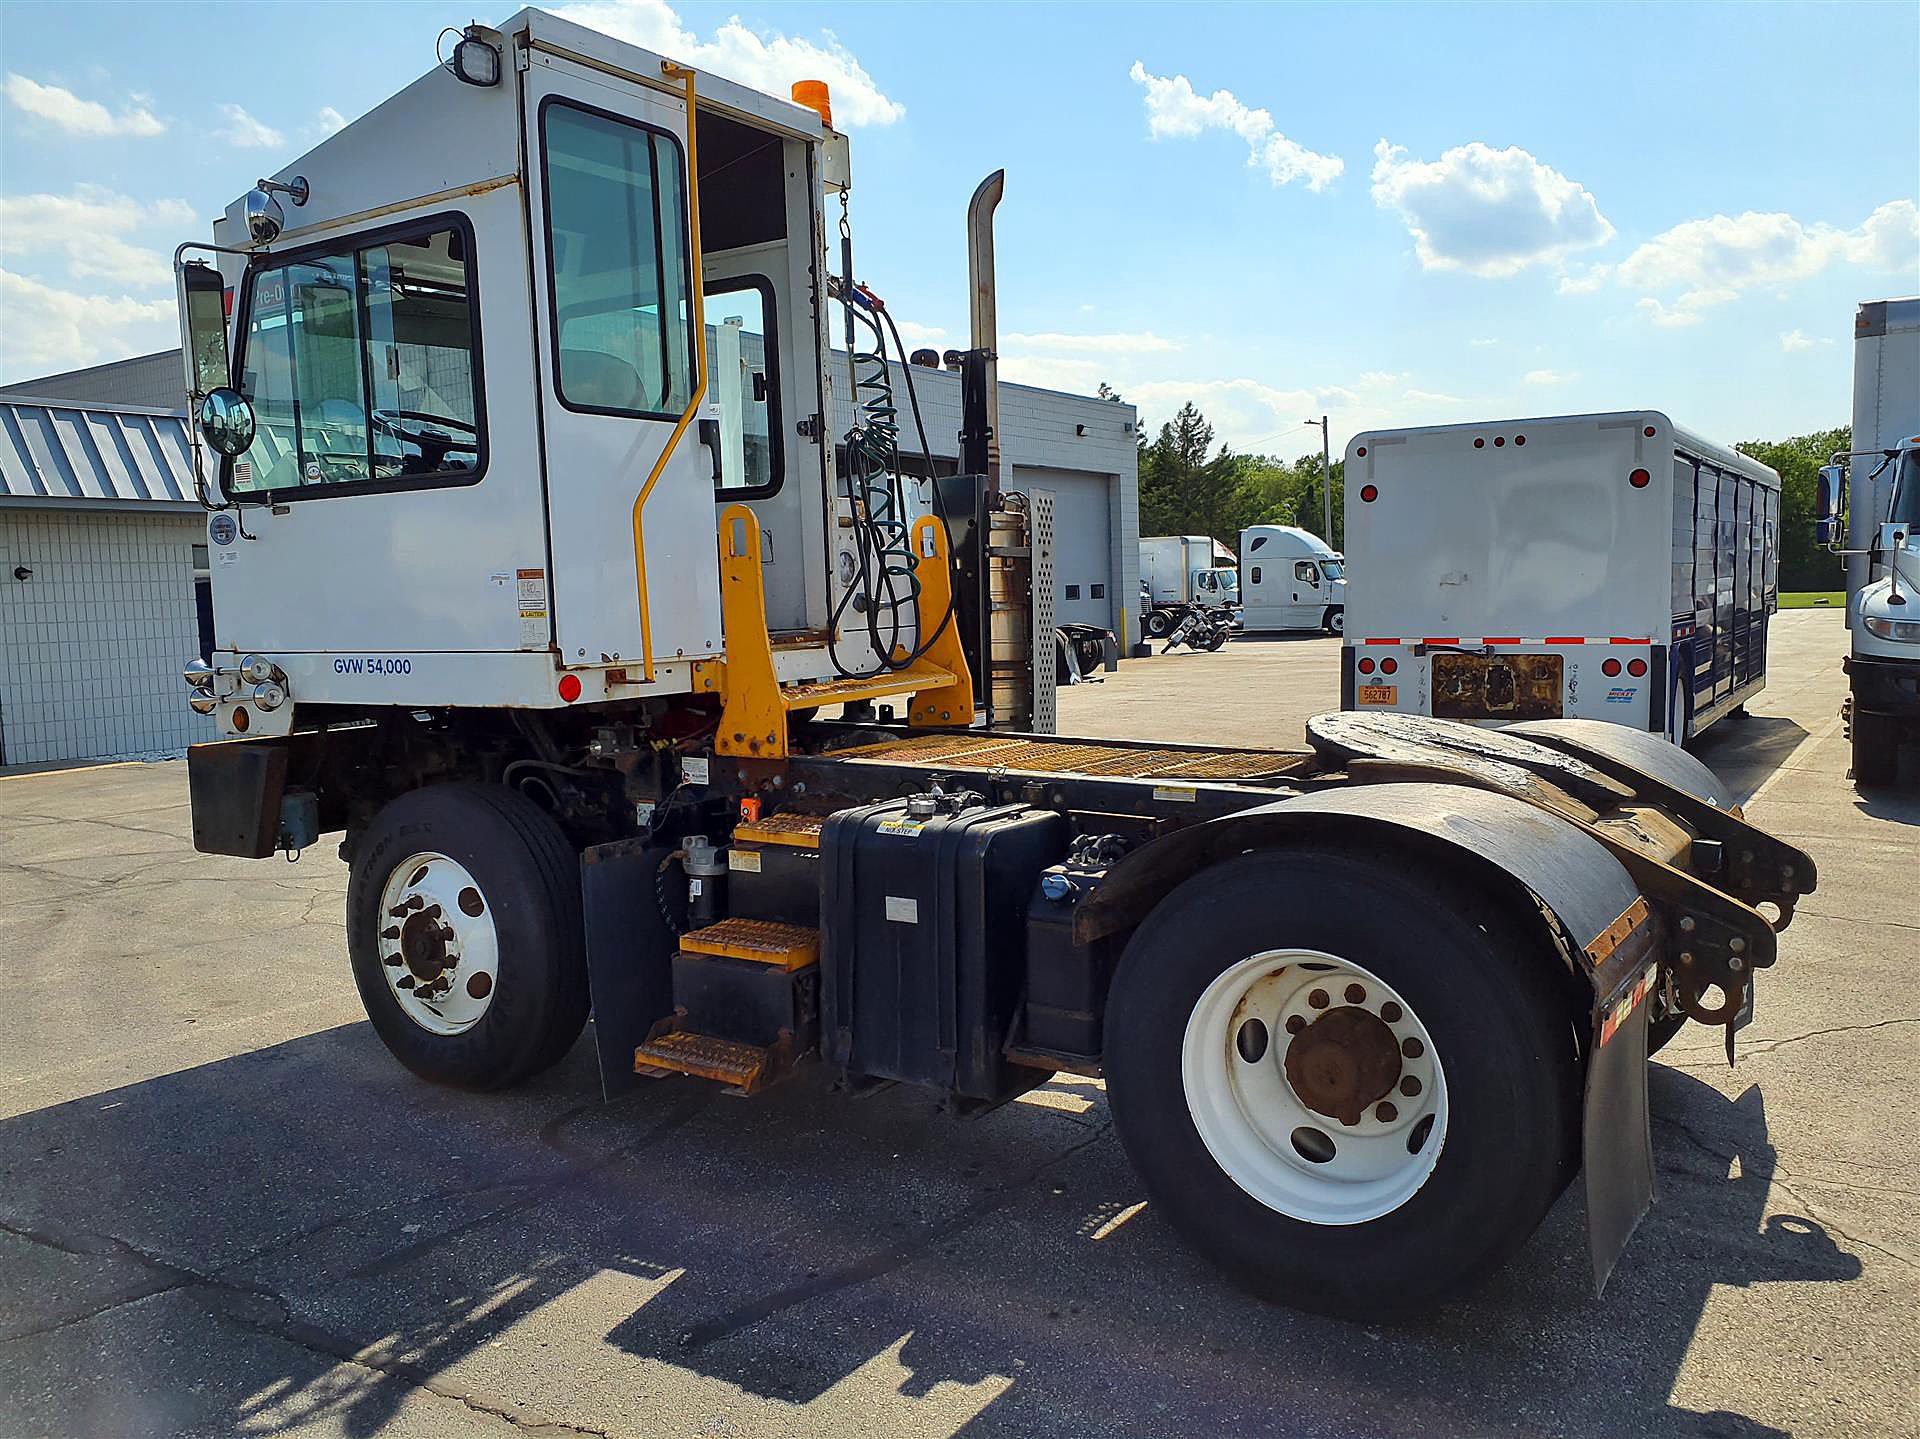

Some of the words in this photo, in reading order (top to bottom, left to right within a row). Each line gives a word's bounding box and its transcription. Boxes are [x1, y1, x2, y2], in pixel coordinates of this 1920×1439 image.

[334, 659, 363, 674] GVW
[367, 659, 411, 676] 54,000
[1364, 690, 1391, 700] 562787
[897, 827, 913, 835] STEP
